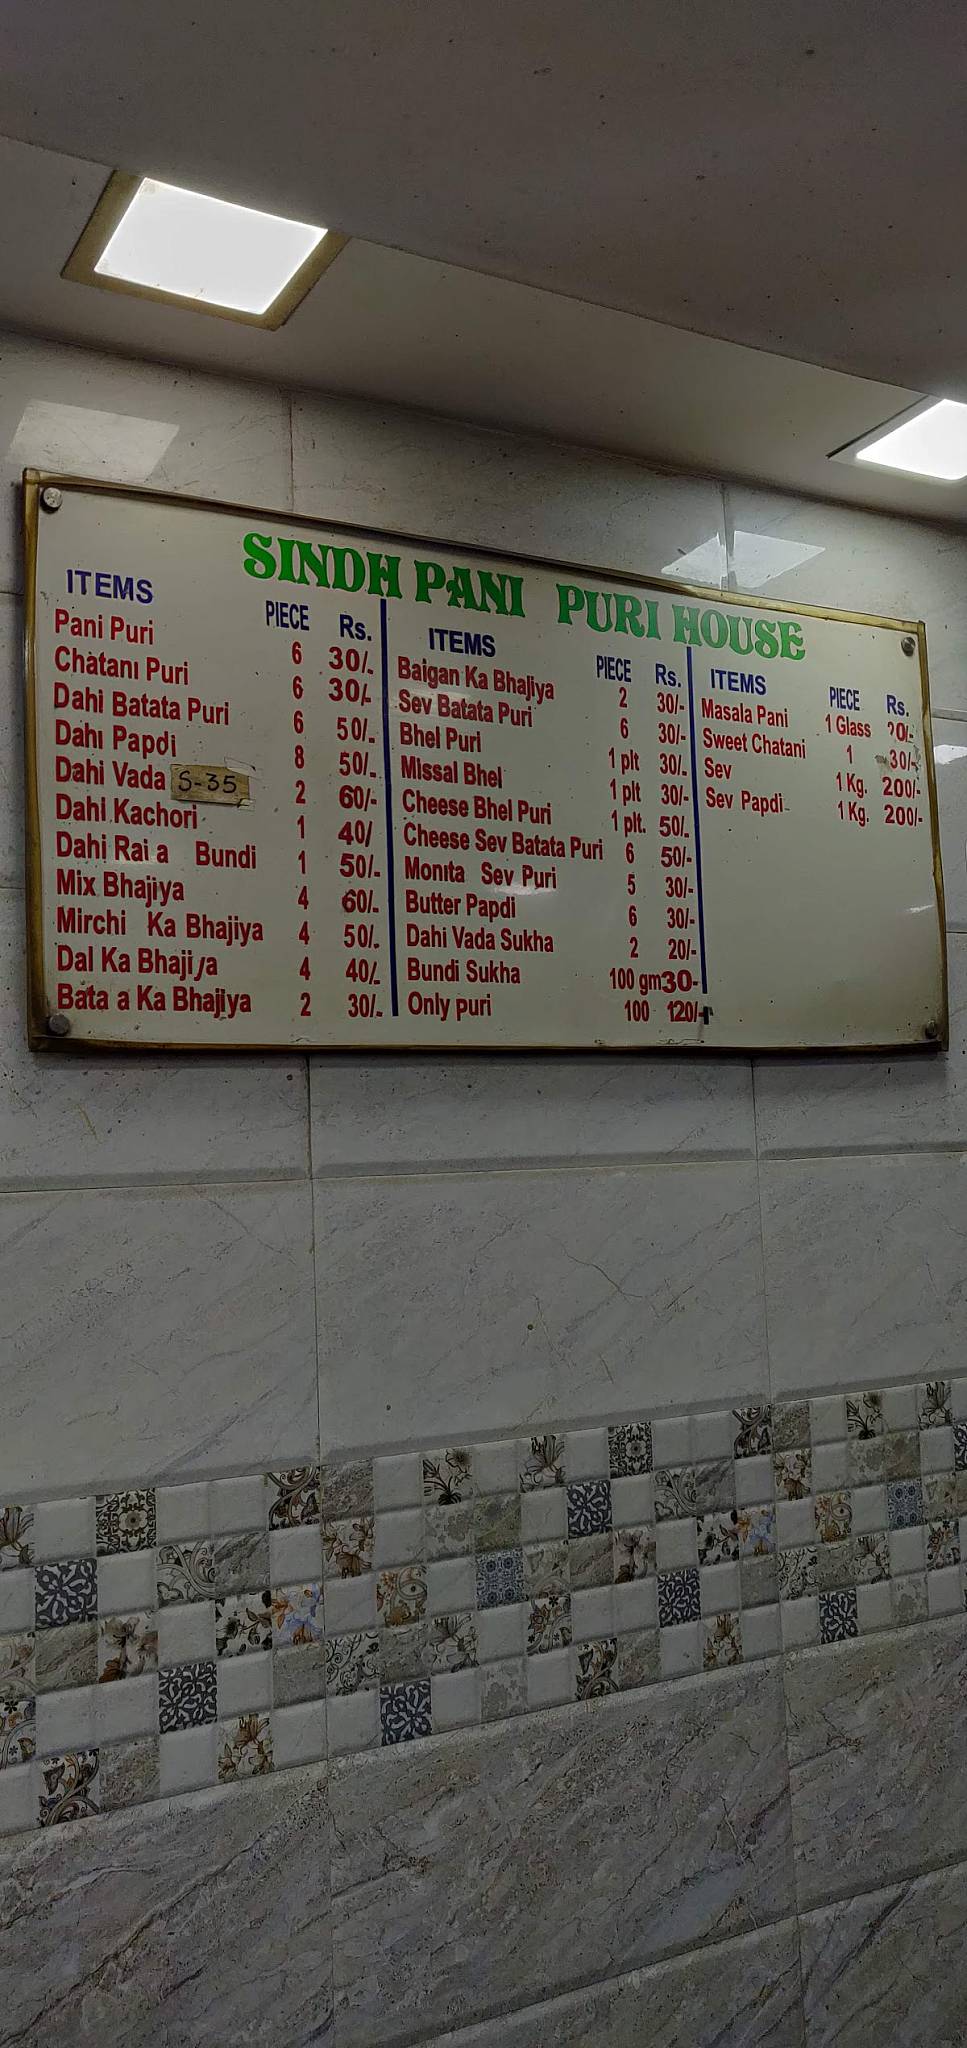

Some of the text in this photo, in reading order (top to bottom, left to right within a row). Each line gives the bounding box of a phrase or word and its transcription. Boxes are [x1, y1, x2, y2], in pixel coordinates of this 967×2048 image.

[66, 569, 373, 642] ITEMS PIECE Rs.
[243, 531, 806, 660] SINDH PANI PURI HOUSE
[54, 608, 104, 640] Pani
[110, 615, 154, 645] Puri
[291, 641, 302, 665] 6
[428, 627, 682, 688] ITEMS PIECE Rs.
[146, 656, 189, 685] Puri
[291, 676, 303, 700] 6
[397, 655, 460, 689] Baigan
[465, 664, 489, 690] Ka
[493, 668, 555, 705] Bhajiya
[619, 687, 628, 709] 2
[710, 668, 910, 717] ITEMS PIECE Rs.
[53, 682, 104, 714] Dahi
[112, 691, 181, 721] Batata
[187, 697, 229, 726] Puri
[293, 710, 304, 735] 6
[398, 689, 432, 716] Sev
[437, 696, 493, 724] Batata
[498, 700, 533, 728] Puri
[619, 717, 629, 739] 6
[701, 698, 753, 724] Masala
[757, 704, 789, 728] Pani
[825, 713, 832, 733] 1
[836, 714, 872, 738] Glass
[112, 725, 177, 760] Papdi
[294, 745, 305, 770] 8
[400, 721, 441, 749] Bhel
[445, 726, 482, 753] Puri
[608, 747, 616, 769] 1
[620, 749, 640, 775] plt
[703, 727, 748, 753] Sweet
[751, 733, 806, 760] Chatani
[846, 744, 853, 764] 1
[55, 755, 105, 786] Dahi
[112, 760, 166, 791] Vada
[295, 780, 306, 805] 2
[178, 770, 237, 794] S-35
[400, 754, 458, 784] Missal
[463, 760, 503, 789] Bhel
[609, 778, 617, 800] 1
[622, 779, 642, 806] plt
[704, 757, 732, 780] Sev
[836, 771, 842, 792] 1
[846, 772, 868, 799] Kg.
[55, 793, 373, 848] Dahi Kachori 1 40/
[402, 788, 469, 818] Cheese
[473, 795, 513, 822] Bhel
[517, 799, 552, 825] Puri
[611, 809, 618, 832] 1
[623, 811, 646, 838] plt.
[705, 787, 734, 810] Sev
[741, 790, 784, 817] Papdi
[837, 800, 844, 820] 1
[848, 801, 869, 827] Kg.
[55, 831, 107, 860] Dahi
[195, 840, 256, 870] Bundi
[297, 850, 306, 875] 1
[403, 821, 470, 851] Cheese
[474, 828, 507, 853] Sev
[512, 831, 566, 859] Batata
[570, 836, 604, 861] Puri
[625, 842, 635, 864] 6
[55, 868, 96, 897] Mix
[103, 871, 185, 908] Bhajiya
[297, 885, 309, 910] 4
[481, 861, 514, 887] Sev
[522, 864, 557, 889] Puri
[627, 873, 636, 896] 5
[56, 906, 127, 935] Mirchi
[147, 911, 176, 938] Ka
[185, 913, 264, 947] Bhajiya
[298, 921, 310, 945] 4
[405, 889, 461, 915] Butter
[466, 893, 516, 923] Papdi
[628, 905, 638, 927] 6
[56, 945, 93, 973] Dal
[101, 946, 131, 973] Ka
[299, 956, 311, 981] 4
[406, 923, 447, 949] Dahi
[451, 925, 496, 950] Vada
[500, 928, 554, 953] Sukha
[629, 936, 639, 959] 2
[407, 957, 460, 983] Bundi
[466, 960, 521, 984] Sukha
[609, 967, 635, 990] 100
[639, 973, 662, 996] gm
[137, 984, 166, 1012] Ka
[172, 986, 252, 1019] Bhajiya
[300, 992, 311, 1017] 2
[407, 991, 450, 1022] Only
[456, 993, 492, 1022] puri
[624, 1000, 650, 1022] 100
